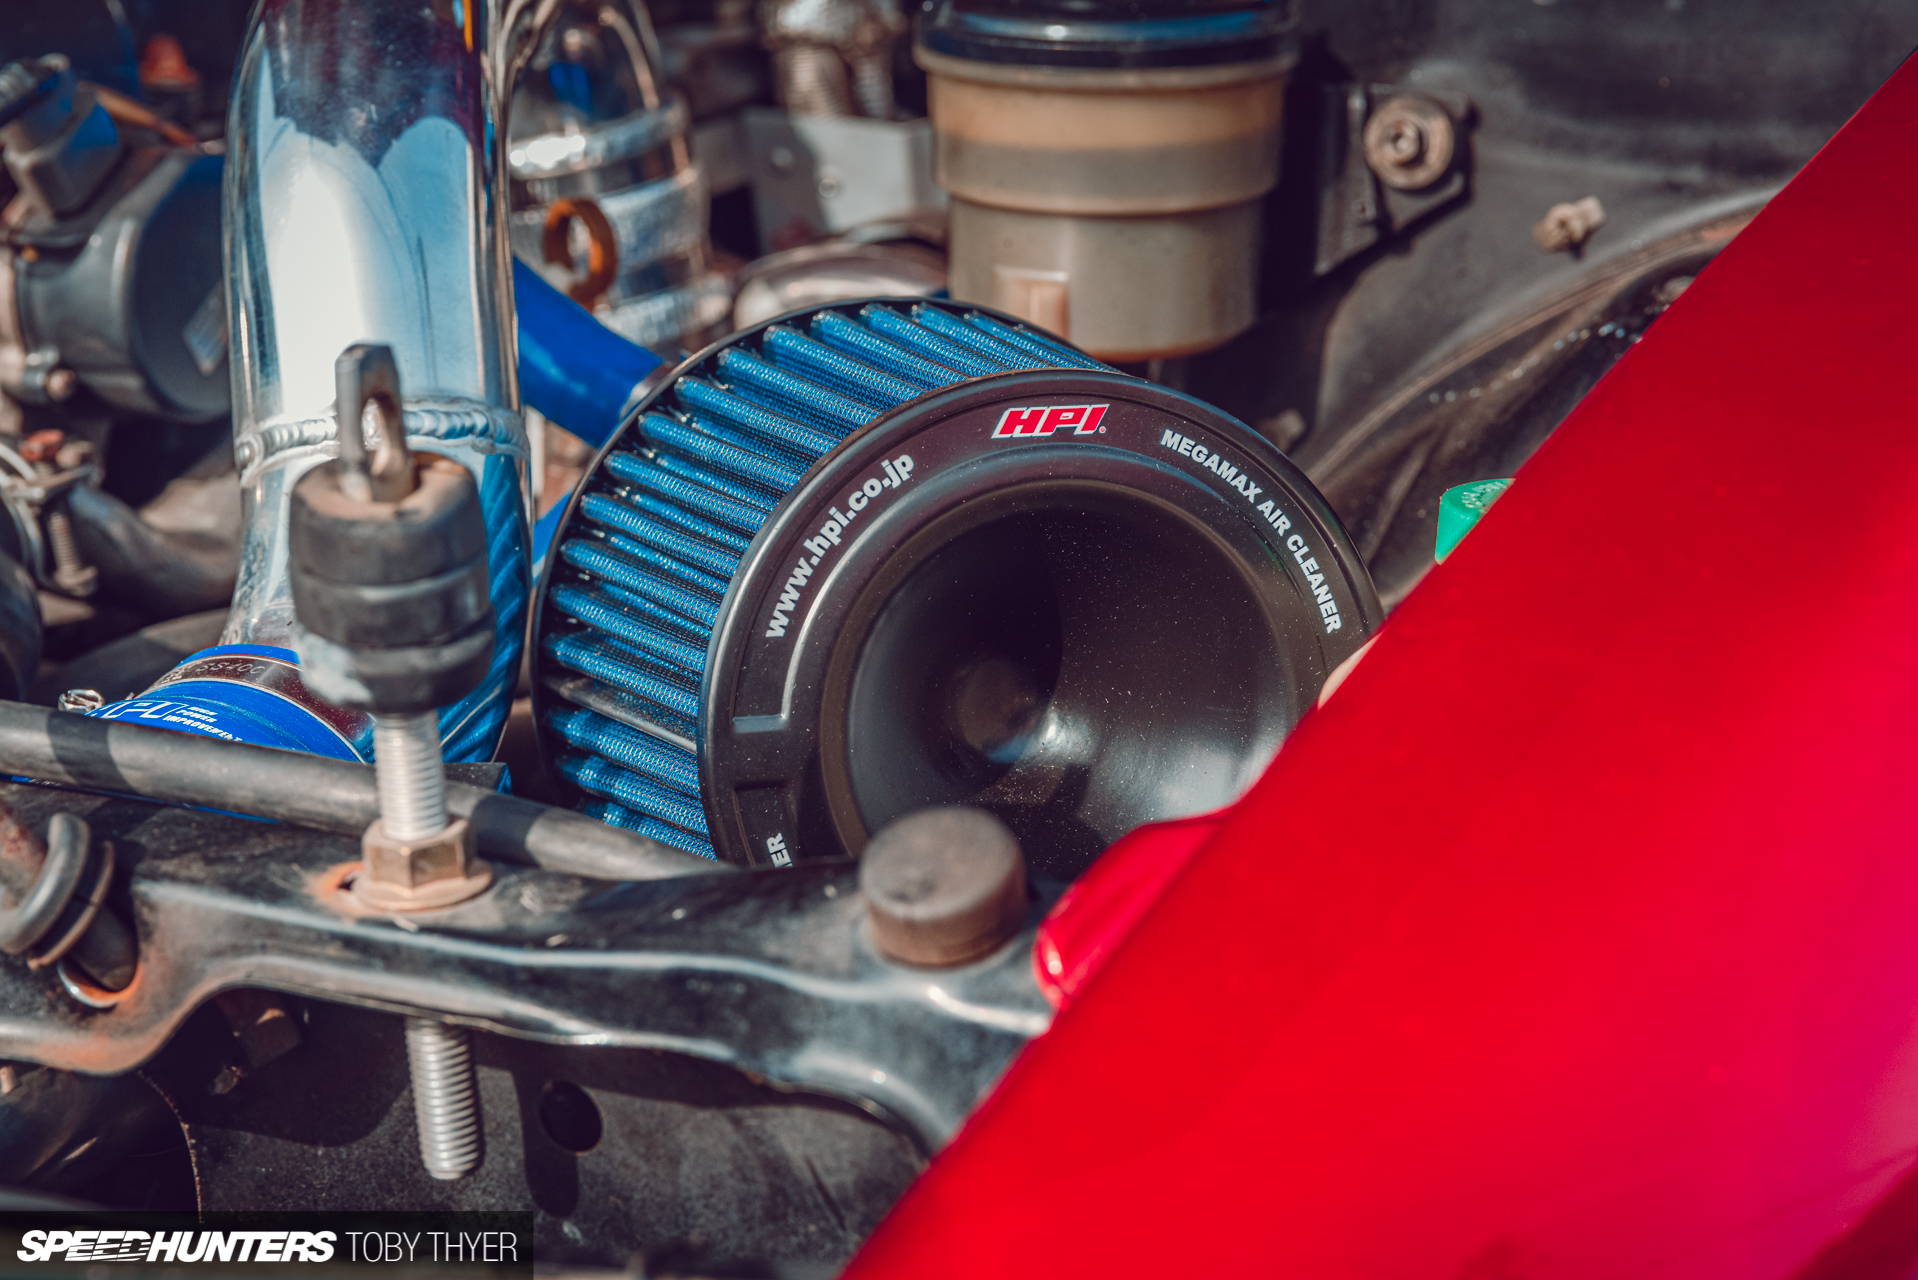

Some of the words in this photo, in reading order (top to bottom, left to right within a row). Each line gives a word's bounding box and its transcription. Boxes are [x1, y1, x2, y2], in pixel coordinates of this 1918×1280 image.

[991, 404, 1110, 438] HPI
[765, 454, 914, 637] www.hpi.co.jp
[1160, 429, 1263, 503] MEGAMAX
[1256, 500, 1292, 537] AIR
[1287, 534, 1342, 634] CLEANER
